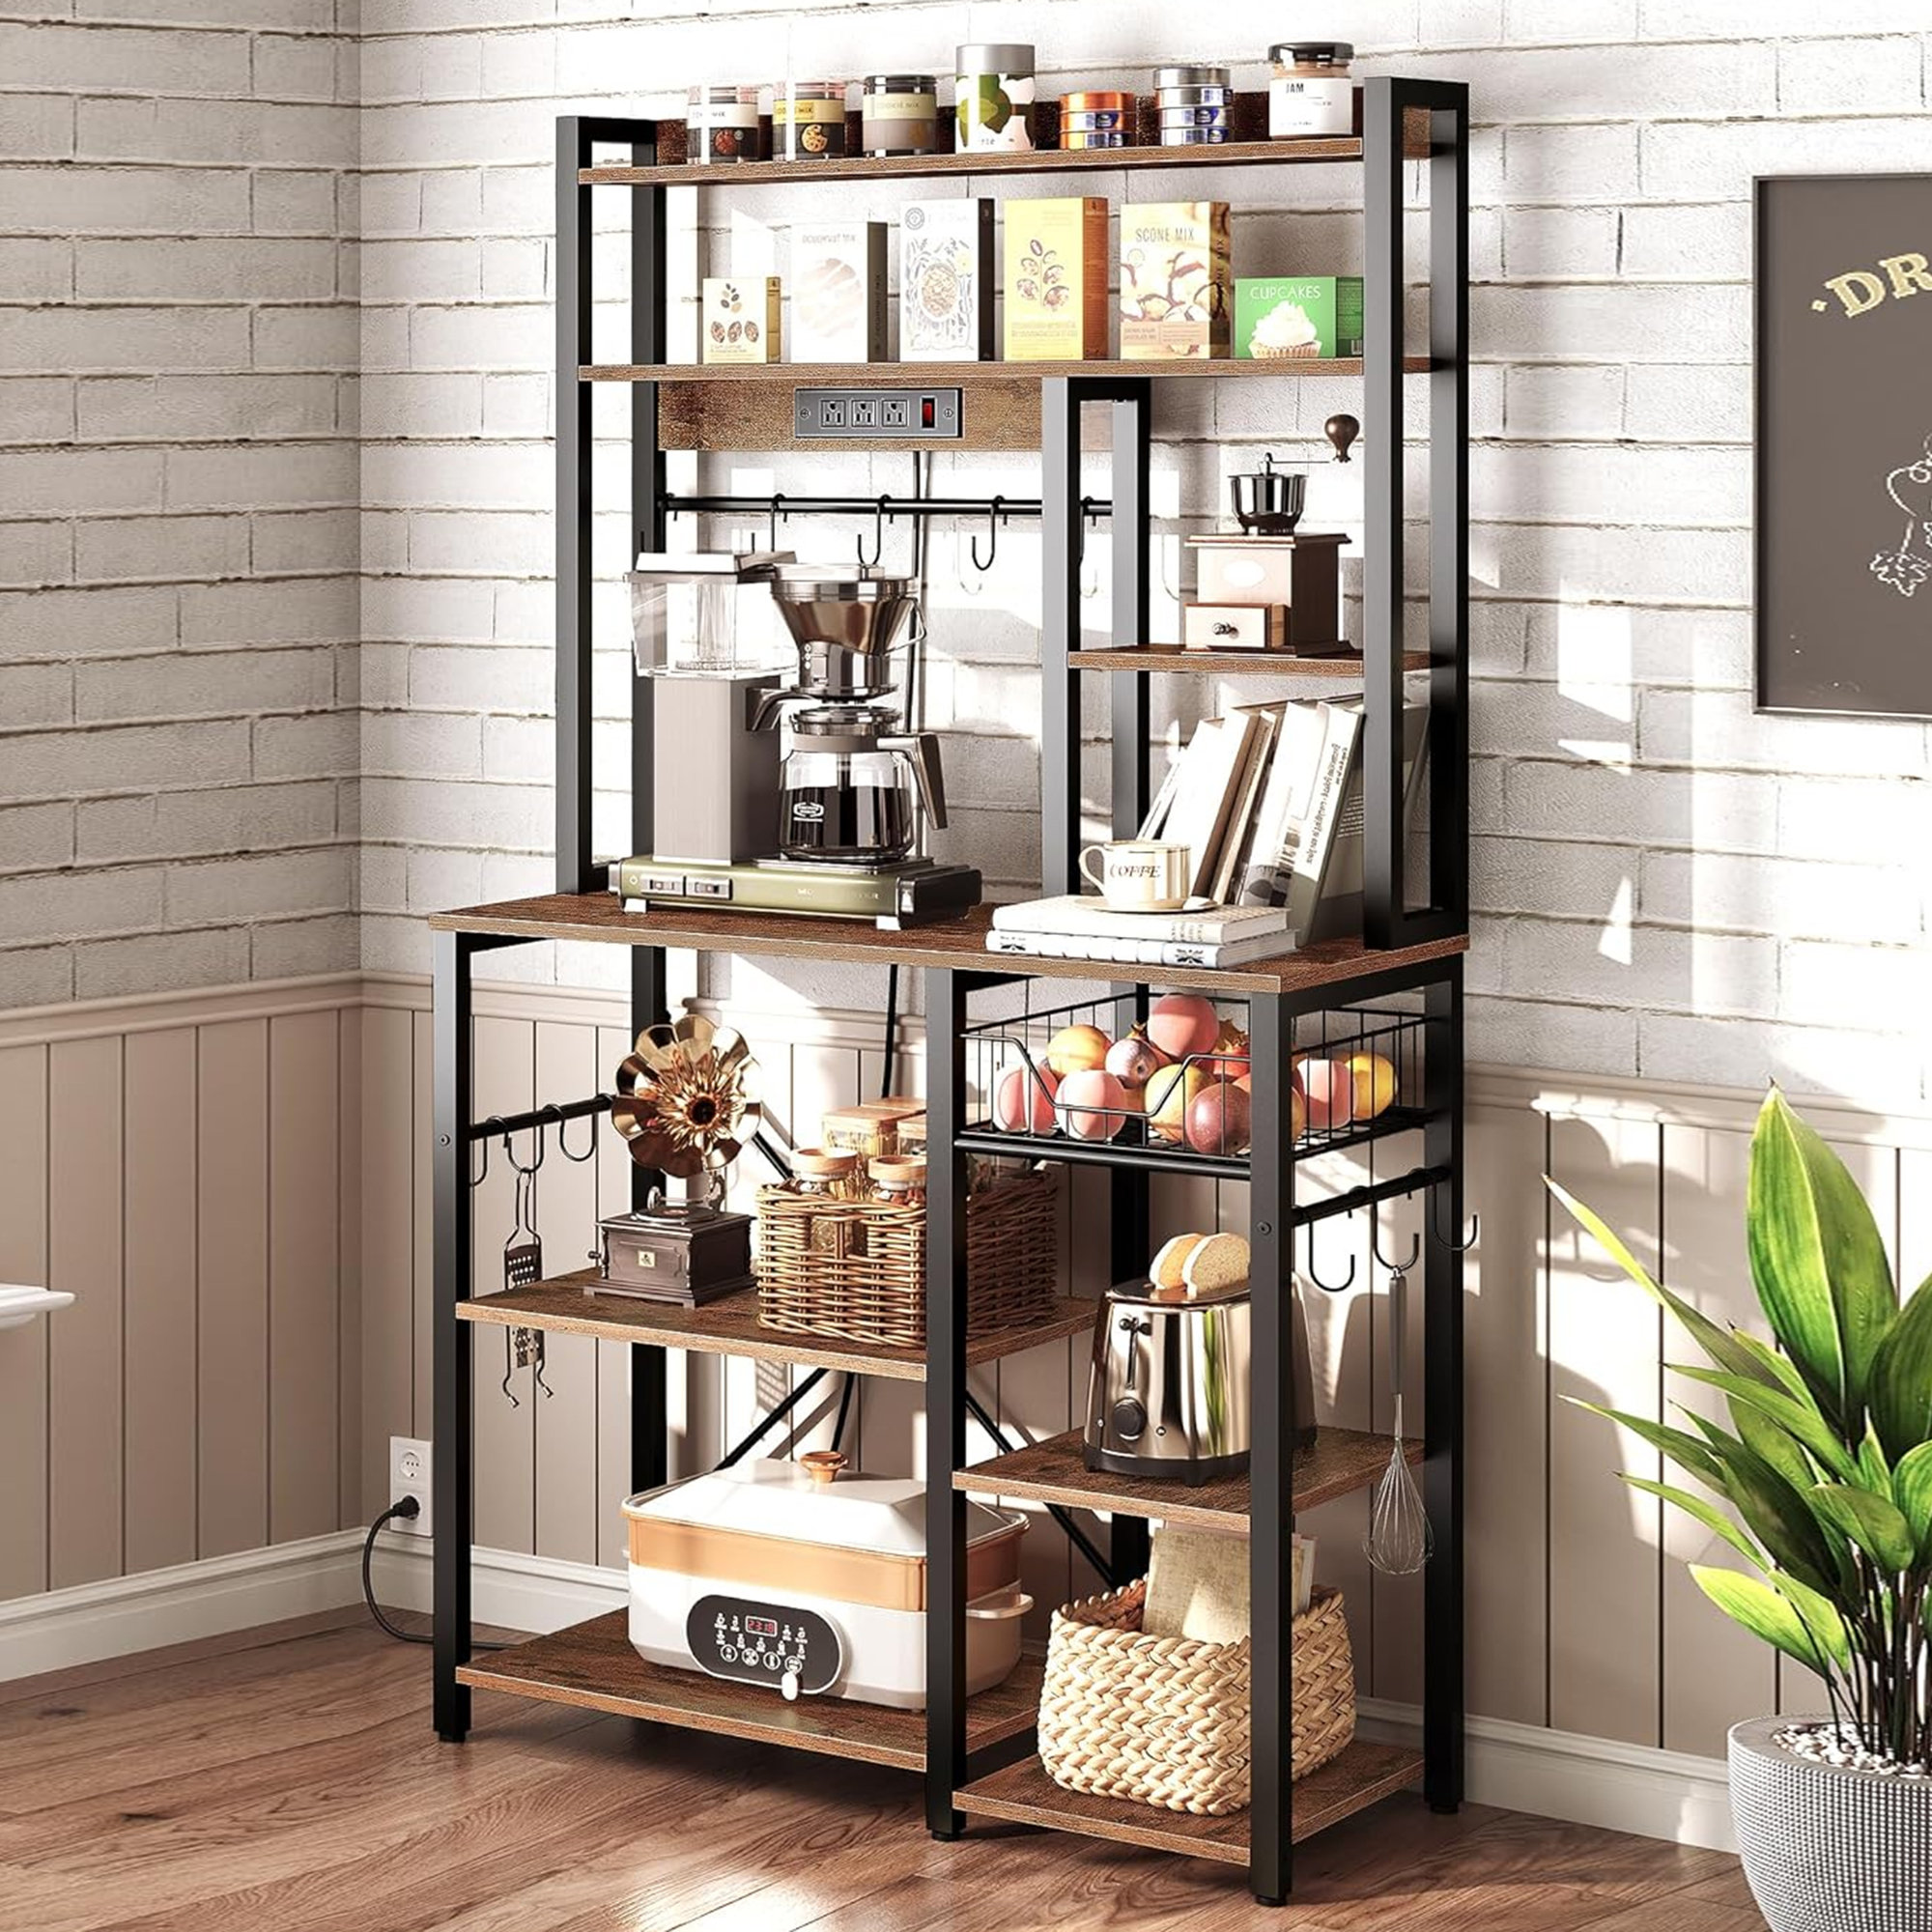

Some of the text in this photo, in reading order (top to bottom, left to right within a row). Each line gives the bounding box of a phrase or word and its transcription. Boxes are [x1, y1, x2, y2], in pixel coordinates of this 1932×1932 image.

[1286, 83, 1304, 93] JAM
[1135, 227, 1195, 242] SCONE MIX
[1250, 285, 1321, 300] CUPCAKES
